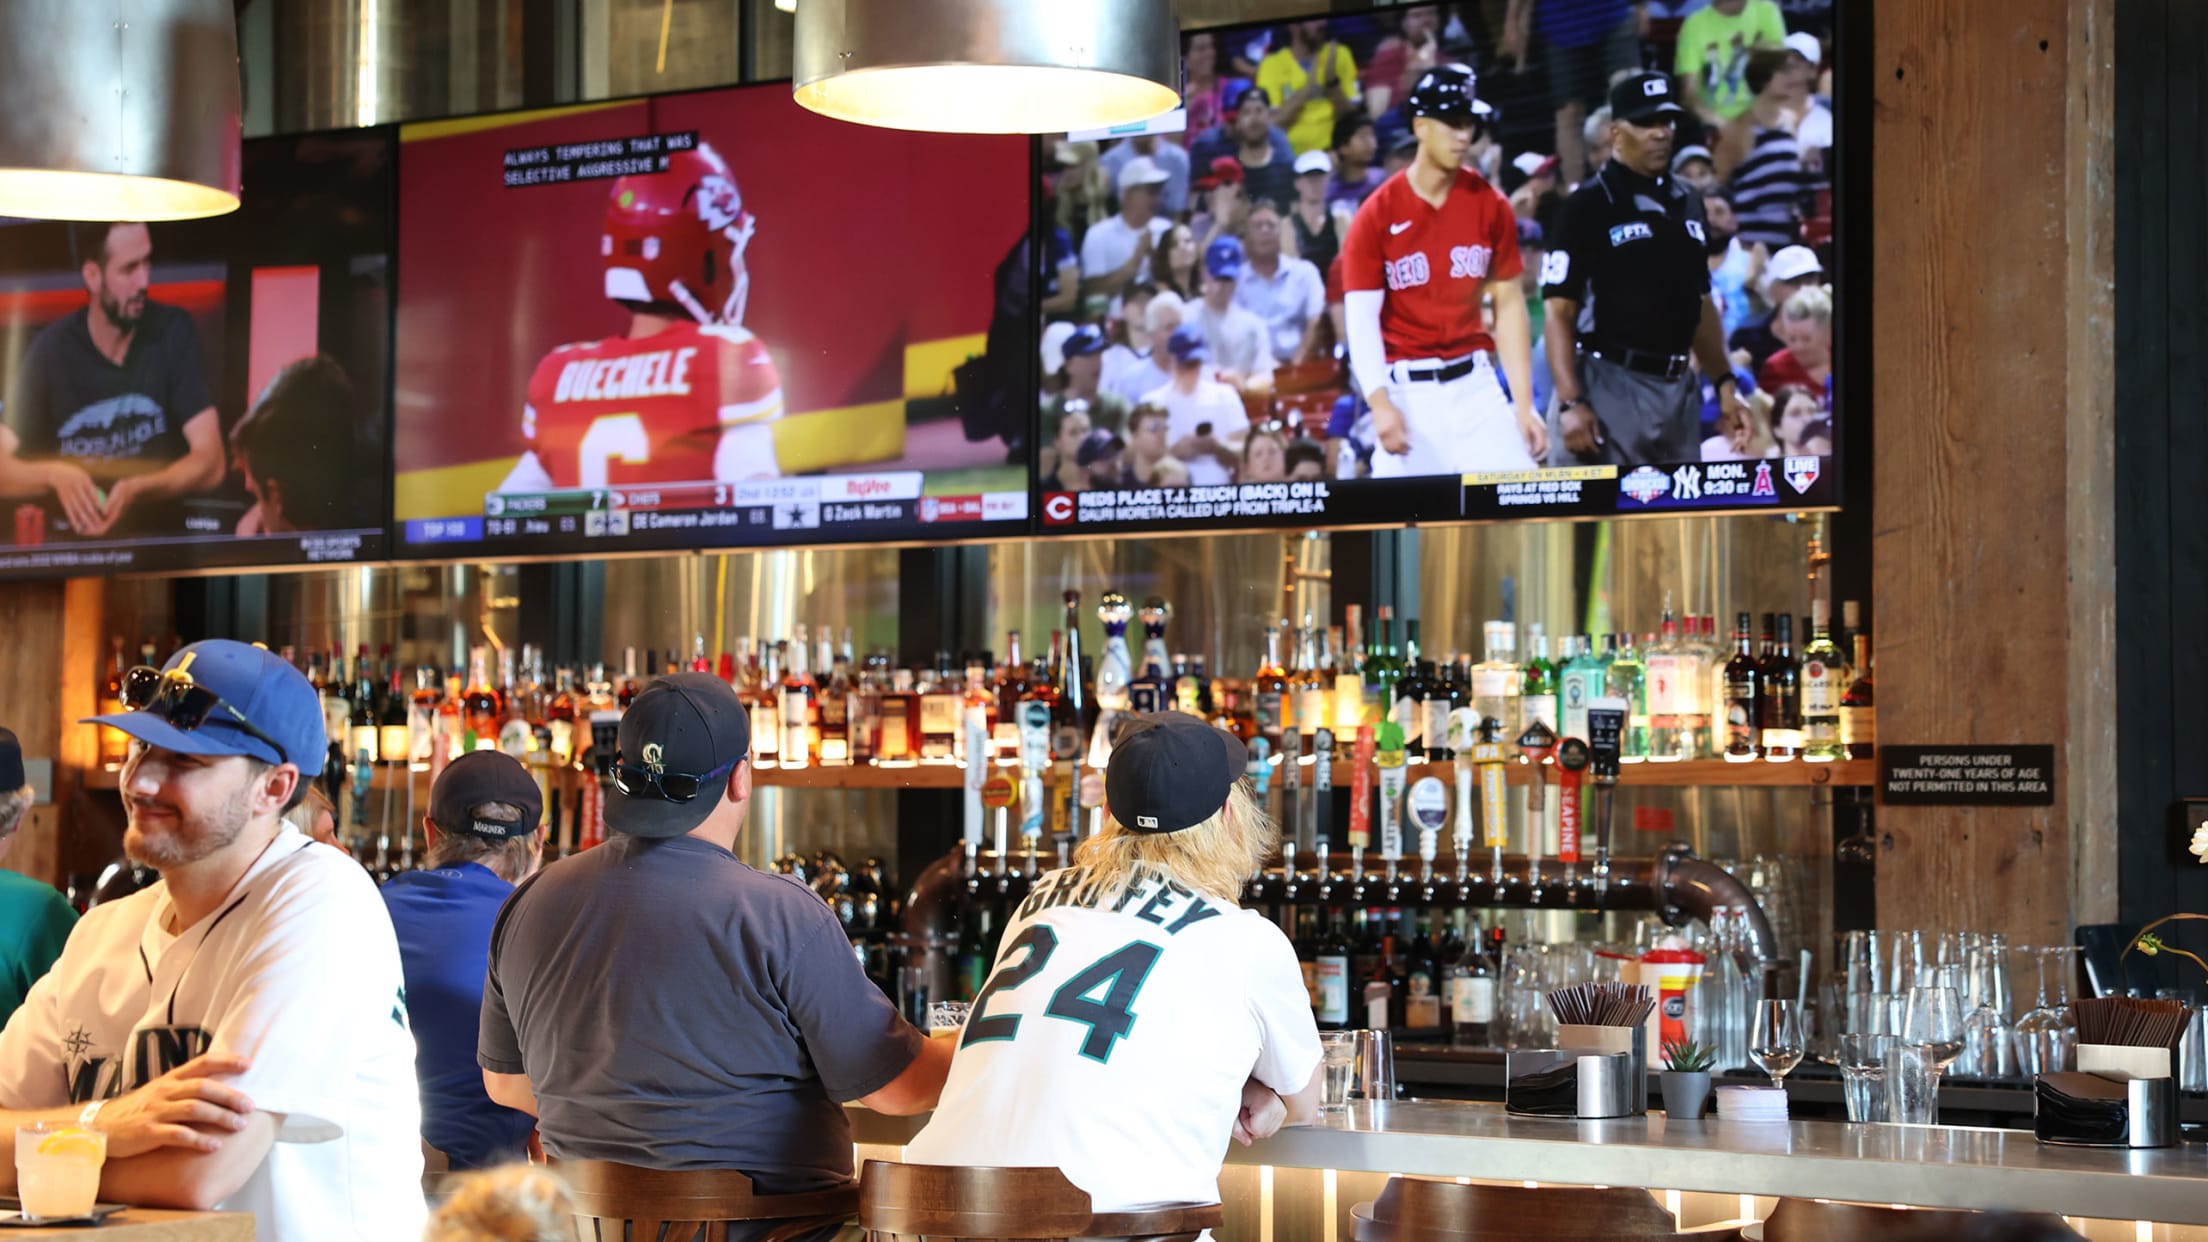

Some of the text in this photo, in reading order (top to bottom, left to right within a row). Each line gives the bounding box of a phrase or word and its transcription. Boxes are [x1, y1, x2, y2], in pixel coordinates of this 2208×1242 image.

[504, 133, 692, 167] ALWAYS TEMPERING THAT WAS
[504, 165, 571, 186] SELECTIVE
[577, 156, 653, 178] AGGRESSIVE
[554, 348, 698, 403] BUECHELE
[1706, 464, 1747, 480] MON.
[1788, 459, 1817, 472] LIVE
[1477, 472, 1526, 482] SATURDAY
[1528, 471, 1542, 480] ON
[714, 485, 727, 505] 3
[1078, 490, 1116, 507] REDS
[1117, 488, 1163, 506] PLACE
[1163, 487, 1188, 505] T.J.
[1189, 486, 1238, 503] ZEUCH
[1239, 483, 1289, 501] (BACK)
[1290, 482, 1314, 498] ON
[1497, 480, 1583, 495] RAYS AT RED SOX
[1704, 480, 1750, 495] 9:30 ET
[592, 491, 603, 511] 7
[1498, 492, 1581, 506] SPRINGS VS HILL
[649, 512, 698, 529] Cameron
[699, 510, 739, 528] Jordan
[835, 504, 862, 521] Zack
[863, 504, 903, 520] Martin
[1116, 503, 1166, 521] MORETA
[1166, 502, 1214, 519] CALLED
[1214, 501, 1233, 517] UP
[1233, 500, 1270, 516] FROM
[1270, 498, 1326, 515] TRIPLE-A
[1919, 754, 2012, 766] PERSONS UNDER
[1892, 767, 2041, 779] TWENTY-ONE YEARS OF AGE
[1888, 780, 2048, 792] NOT PERMITTED IN THIS AREA
[472, 820, 506, 836] MARINERS
[1561, 786, 1576, 853] SEAPINE
[960, 923, 1165, 1065] 24
